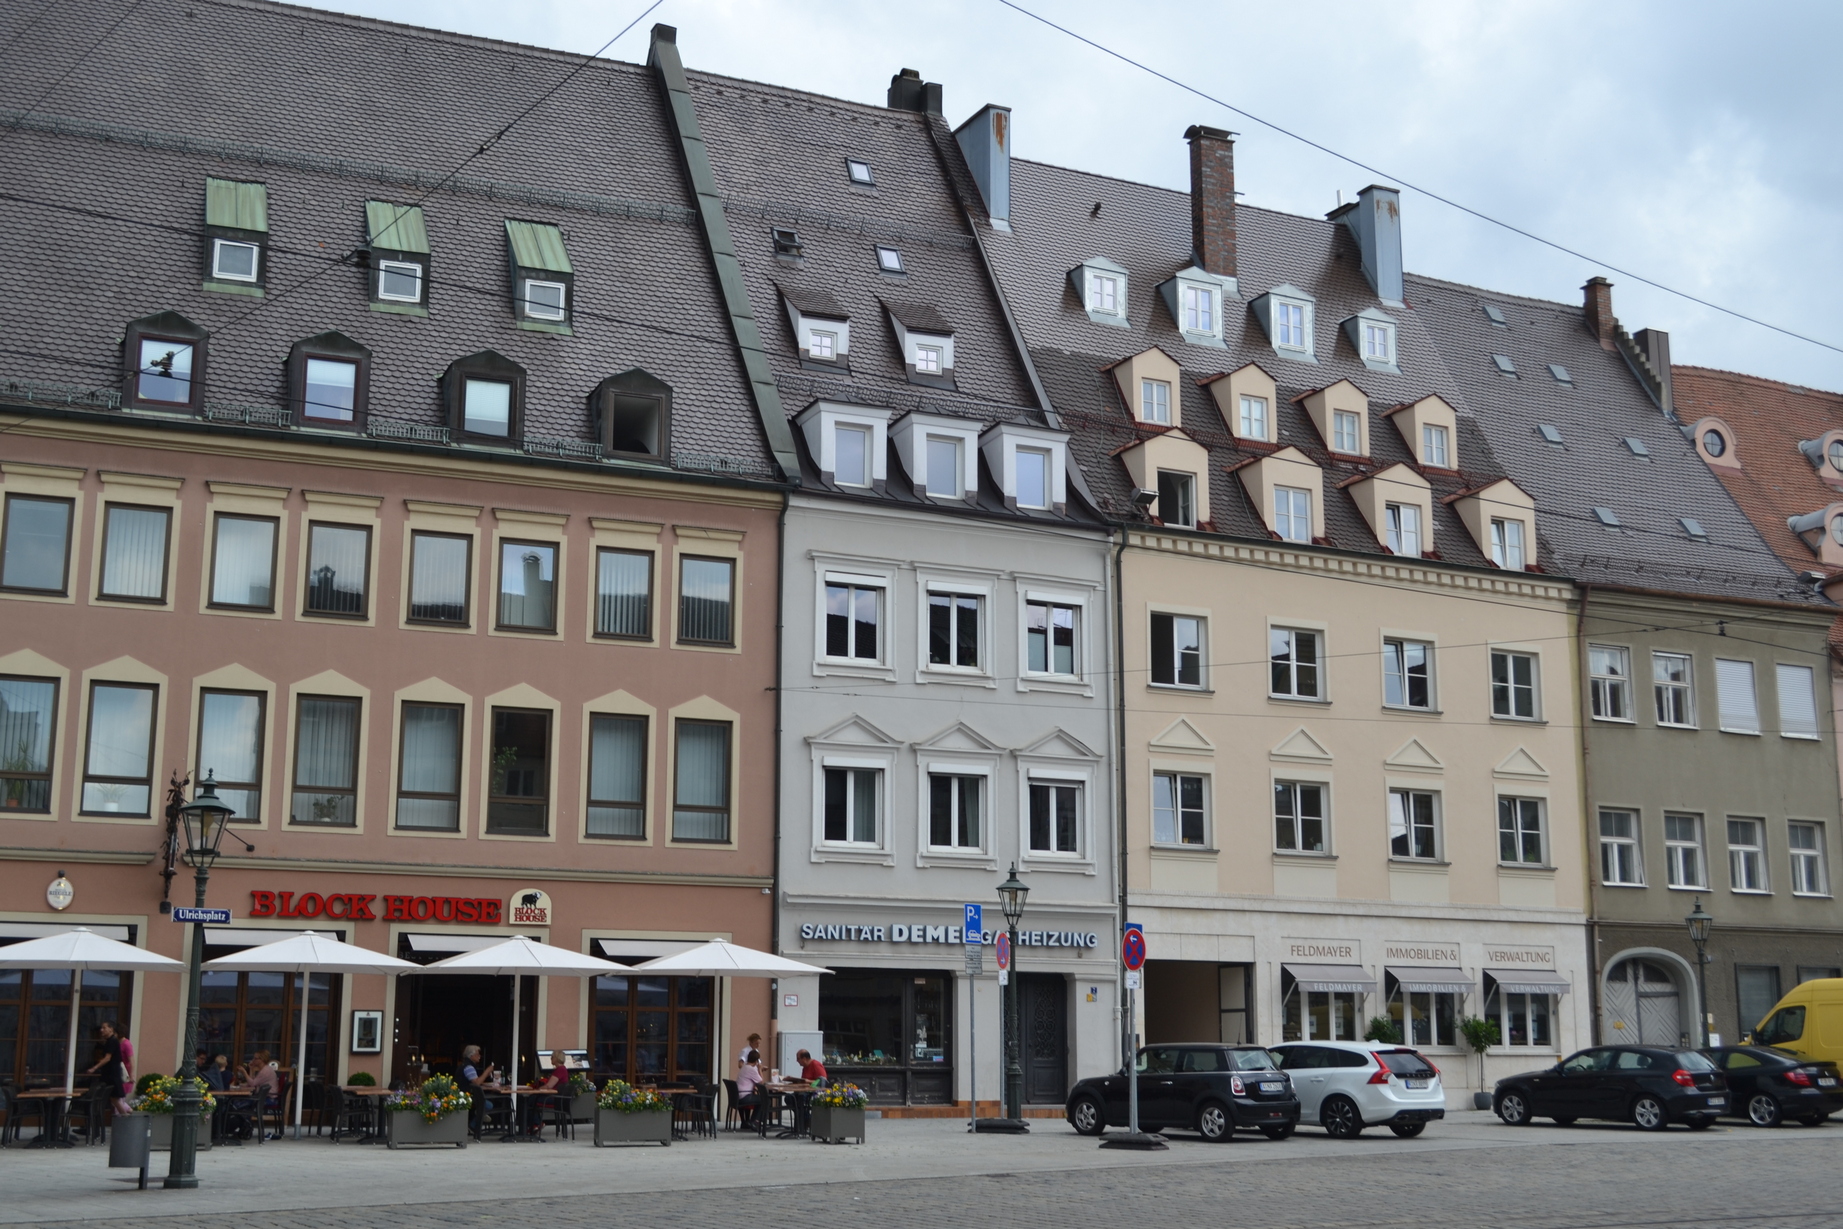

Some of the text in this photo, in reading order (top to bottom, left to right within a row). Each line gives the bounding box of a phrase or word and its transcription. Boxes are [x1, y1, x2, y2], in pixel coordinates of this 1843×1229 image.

[250, 890, 502, 923] BLOCK HOUSE
[514, 907, 547, 916] BLOCK
[179, 909, 227, 922] Ulrichsplatz
[514, 915, 547, 923] HOUSE
[801, 923, 885, 941] SANITÄR
[981, 929, 1010, 945] GA
[1018, 931, 1099, 948] HEIZUNG
[1290, 944, 1352, 958] FELDMAYER
[1386, 947, 1457, 961] IMMOBILIEN &
[1488, 951, 1551, 963] VERWALTUNG
[1313, 982, 1363, 992] FELDMAYER
[1409, 983, 1467, 992] IMMOBILIEN &
[1510, 985, 1561, 993] VERWALTUNG
